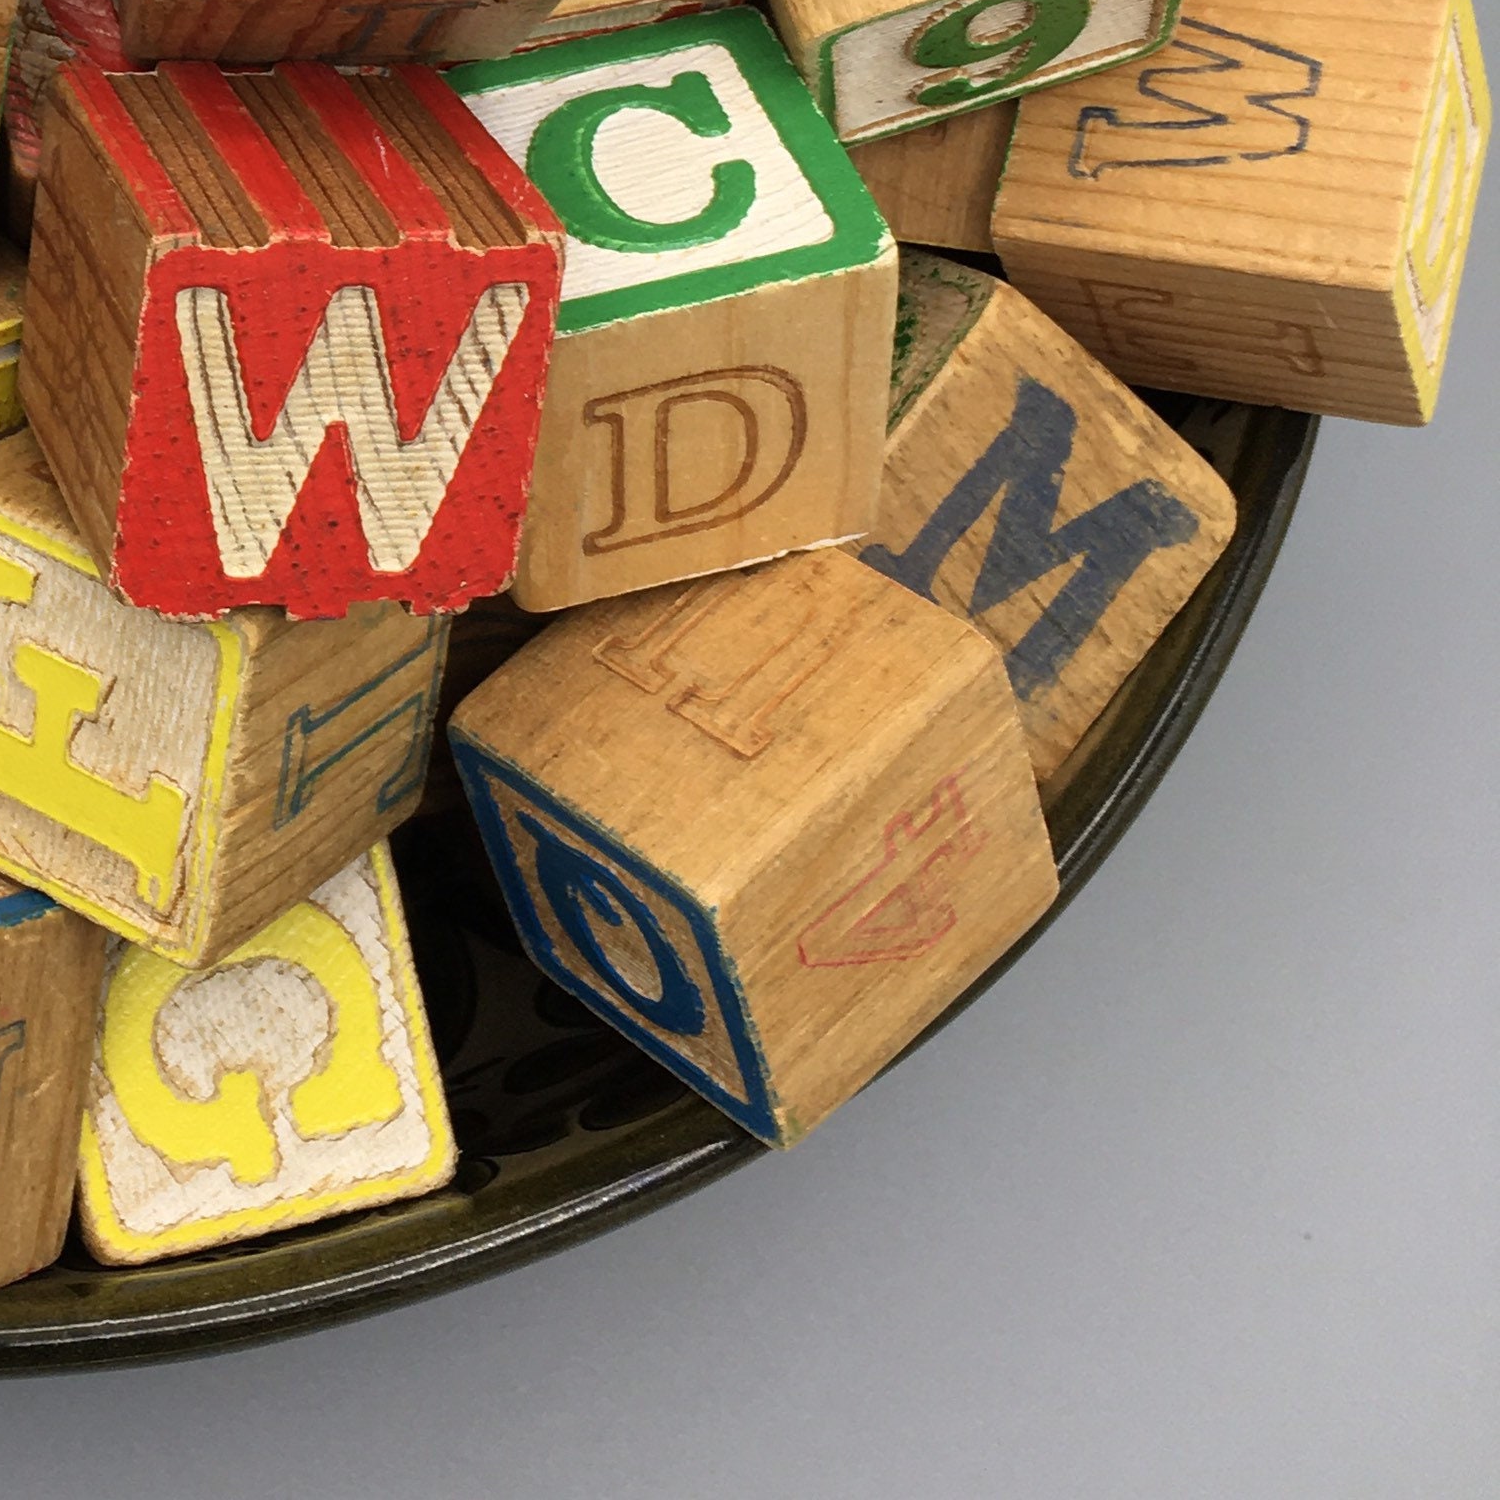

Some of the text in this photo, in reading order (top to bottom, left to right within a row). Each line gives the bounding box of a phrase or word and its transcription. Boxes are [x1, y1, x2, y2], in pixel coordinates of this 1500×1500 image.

[527, 70, 757, 253] C
[174, 281, 531, 579] W
[584, 362, 808, 557] D
[859, 372, 1200, 702] M
